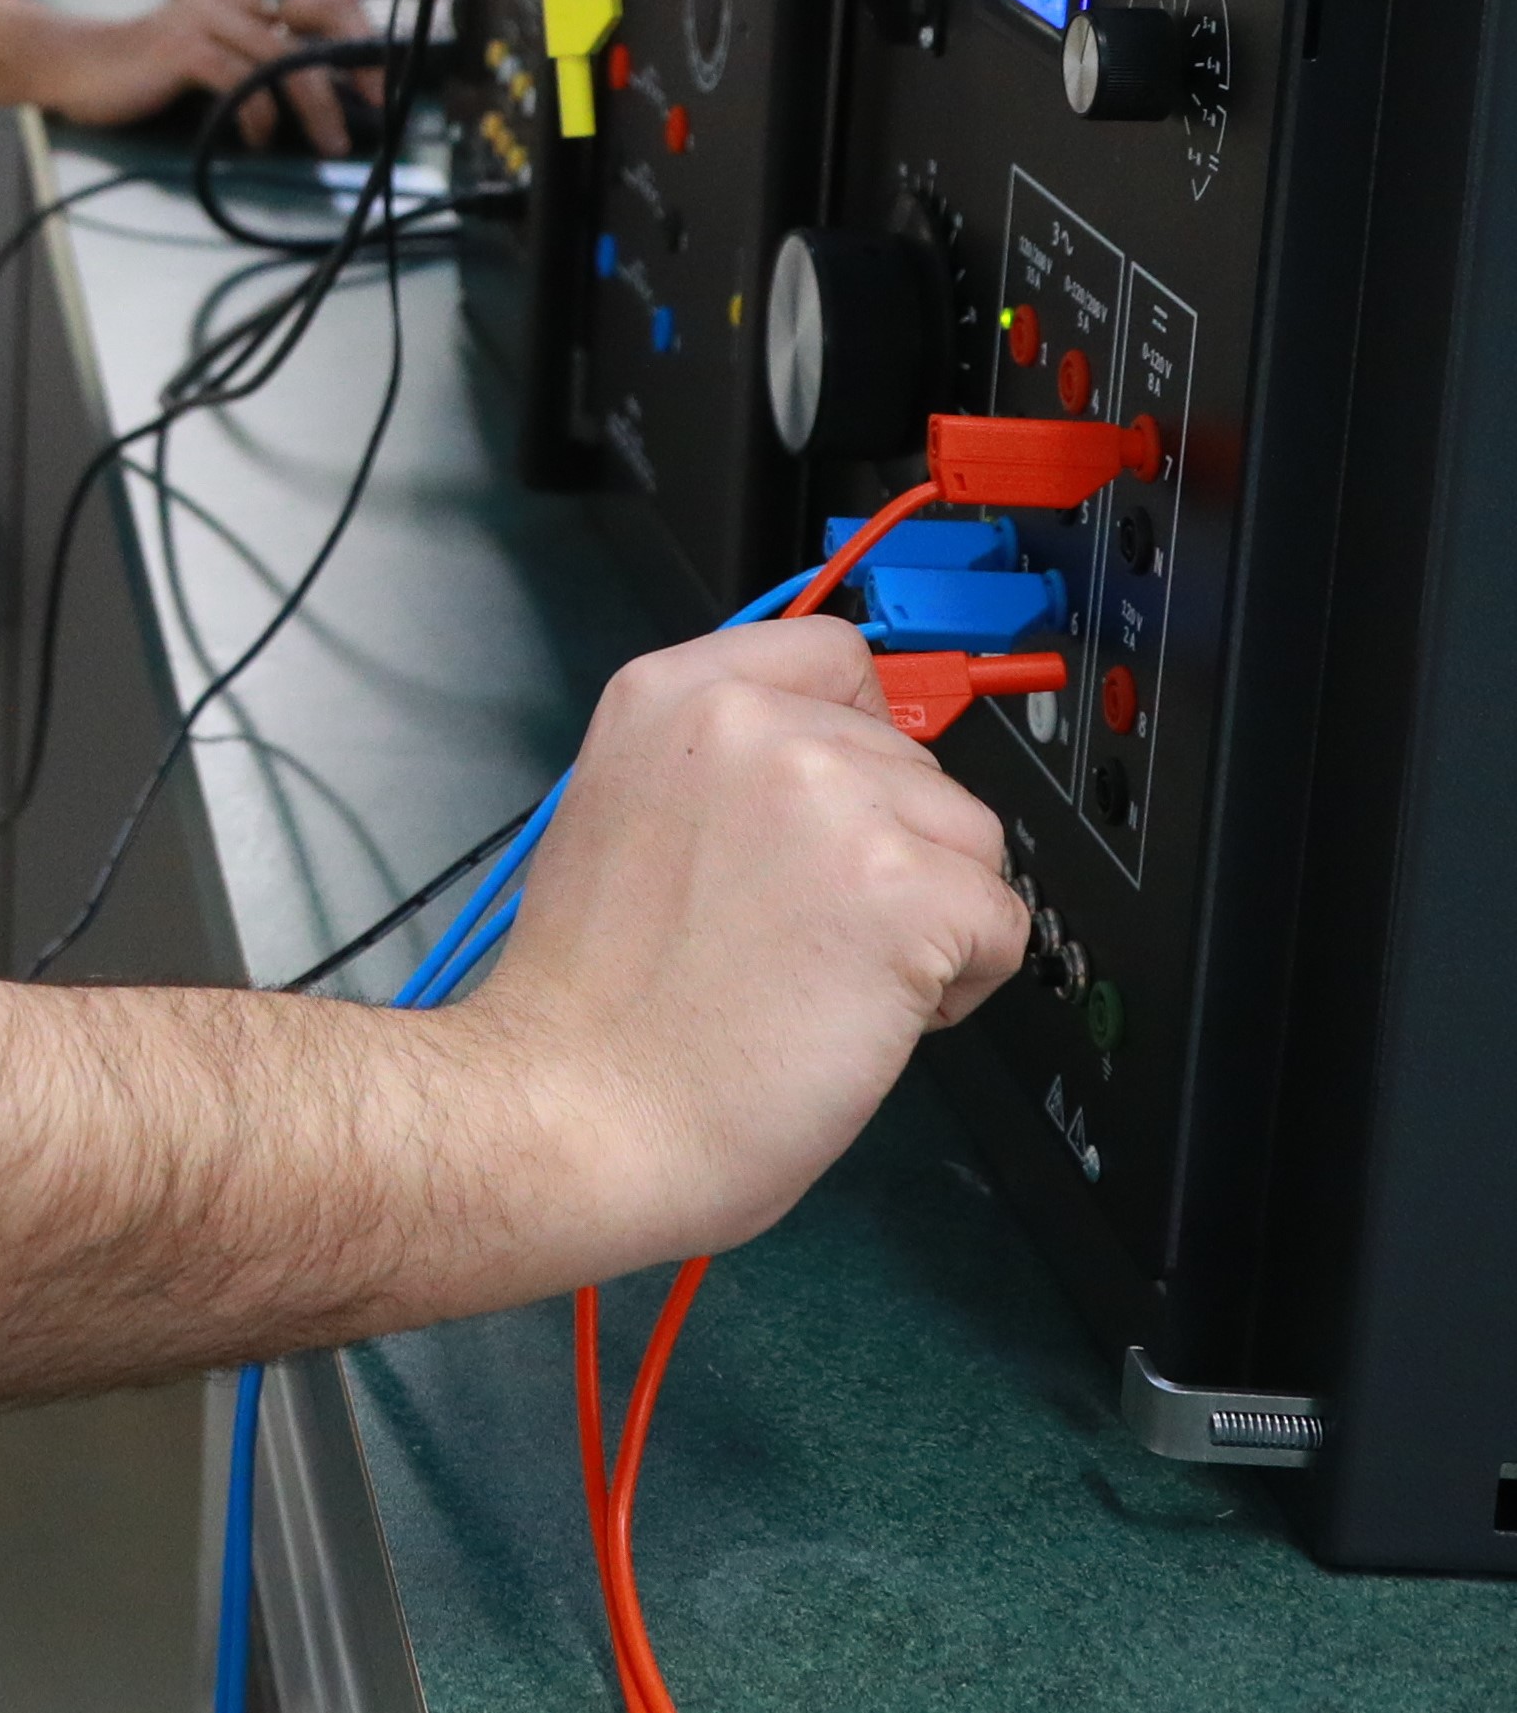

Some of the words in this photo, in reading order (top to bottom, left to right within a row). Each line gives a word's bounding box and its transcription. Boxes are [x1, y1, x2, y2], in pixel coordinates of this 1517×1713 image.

[1046, 258, 1053, 275] V
[1034, 271, 1041, 290] A
[1077, 309, 1083, 328] 5
[1083, 315, 1090, 334] A
[1100, 306, 1108, 323] V
[1040, 342, 1048, 366] 1
[1141, 342, 1165, 374] 0-120
[1165, 360, 1173, 380] V
[1147, 372, 1154, 392] 8
[1154, 377, 1161, 397] A
[1091, 388, 1099, 415] 4
[1163, 455, 1173, 481] 7
[1081, 499, 1090, 524] 5
[1153, 547, 1164, 577] N
[1071, 612, 1079, 636] 6
[1121, 599, 1136, 627] 120
[1136, 613, 1144, 632] V
[1122, 627, 1129, 646] 2
[1129, 632, 1136, 651] A
[1060, 717, 1070, 746] N
[1137, 712, 1147, 738] 8
[1128, 802, 1138, 830] N
